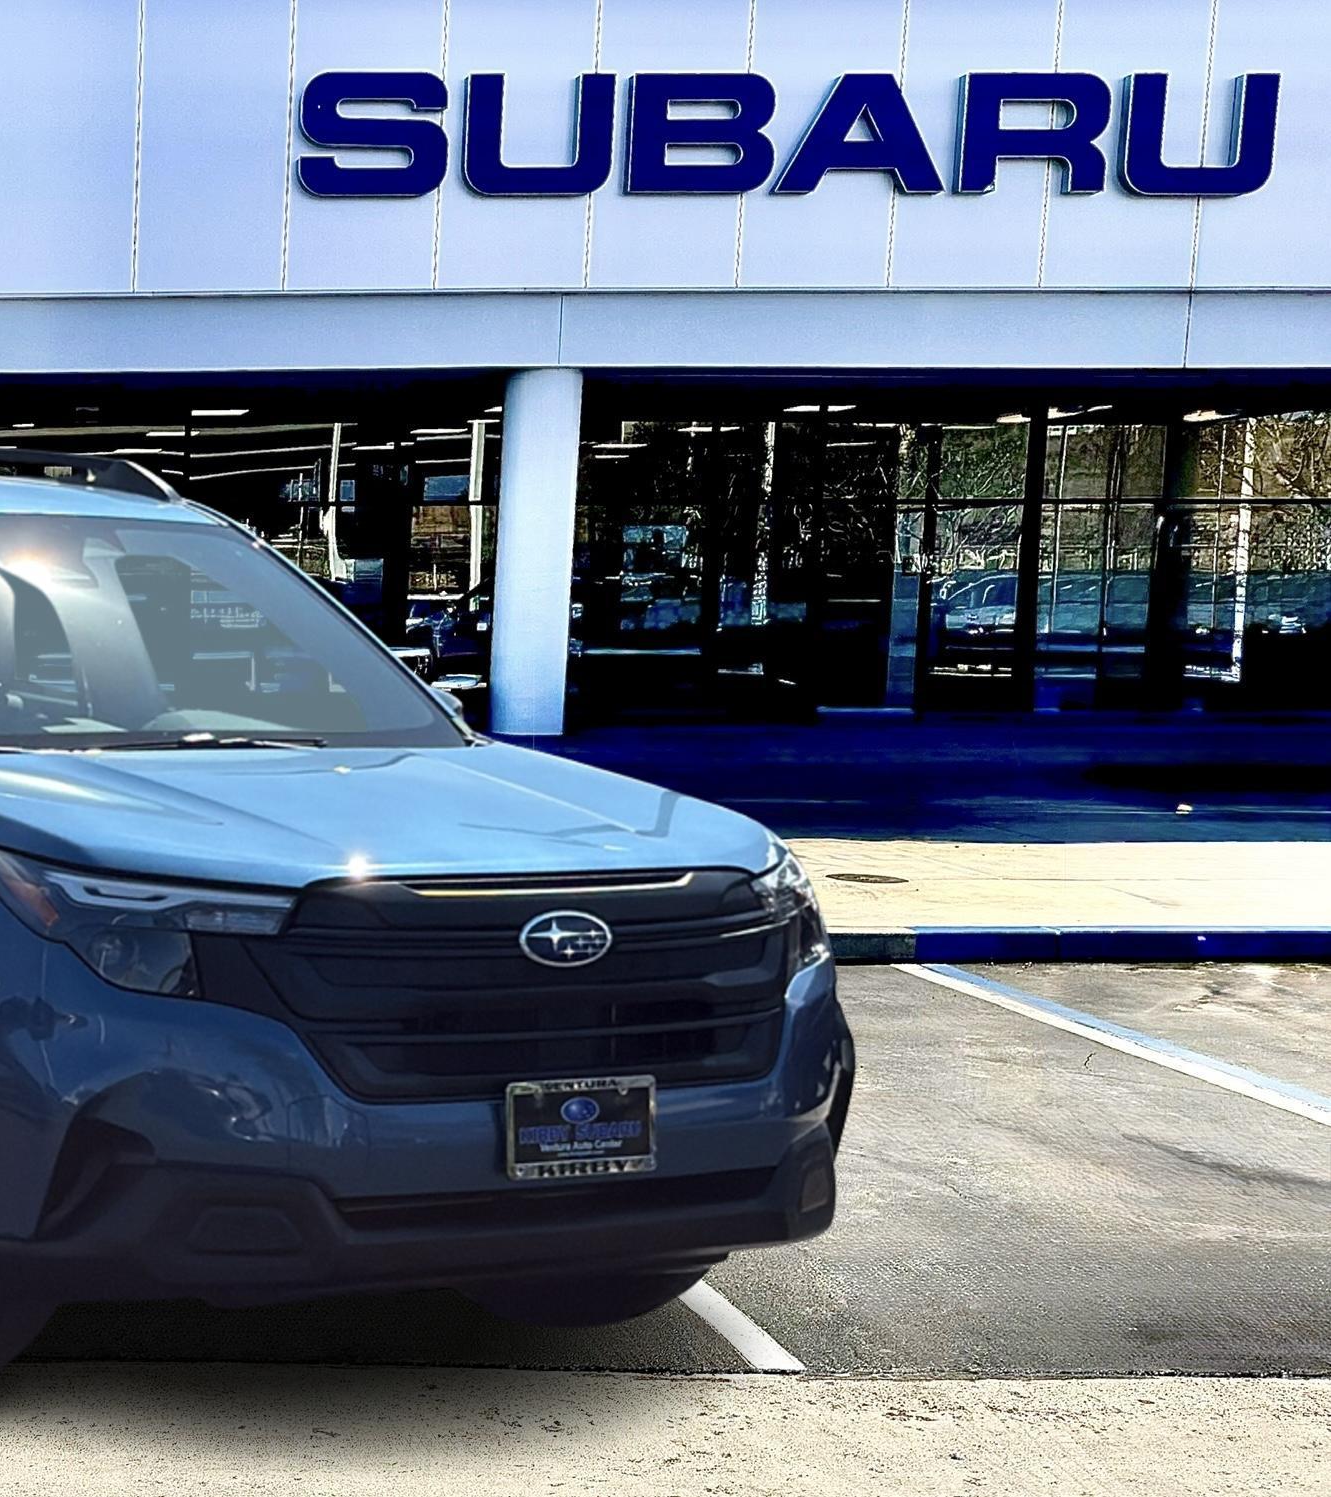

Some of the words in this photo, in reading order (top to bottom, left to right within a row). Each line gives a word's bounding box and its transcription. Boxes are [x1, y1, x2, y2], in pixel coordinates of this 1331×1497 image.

[297, 70, 1282, 197] SUBARU
[573, 1141, 593, 1150] Auto
[595, 1139, 623, 1149] Center
[537, 1160, 632, 1177] KIRBY
